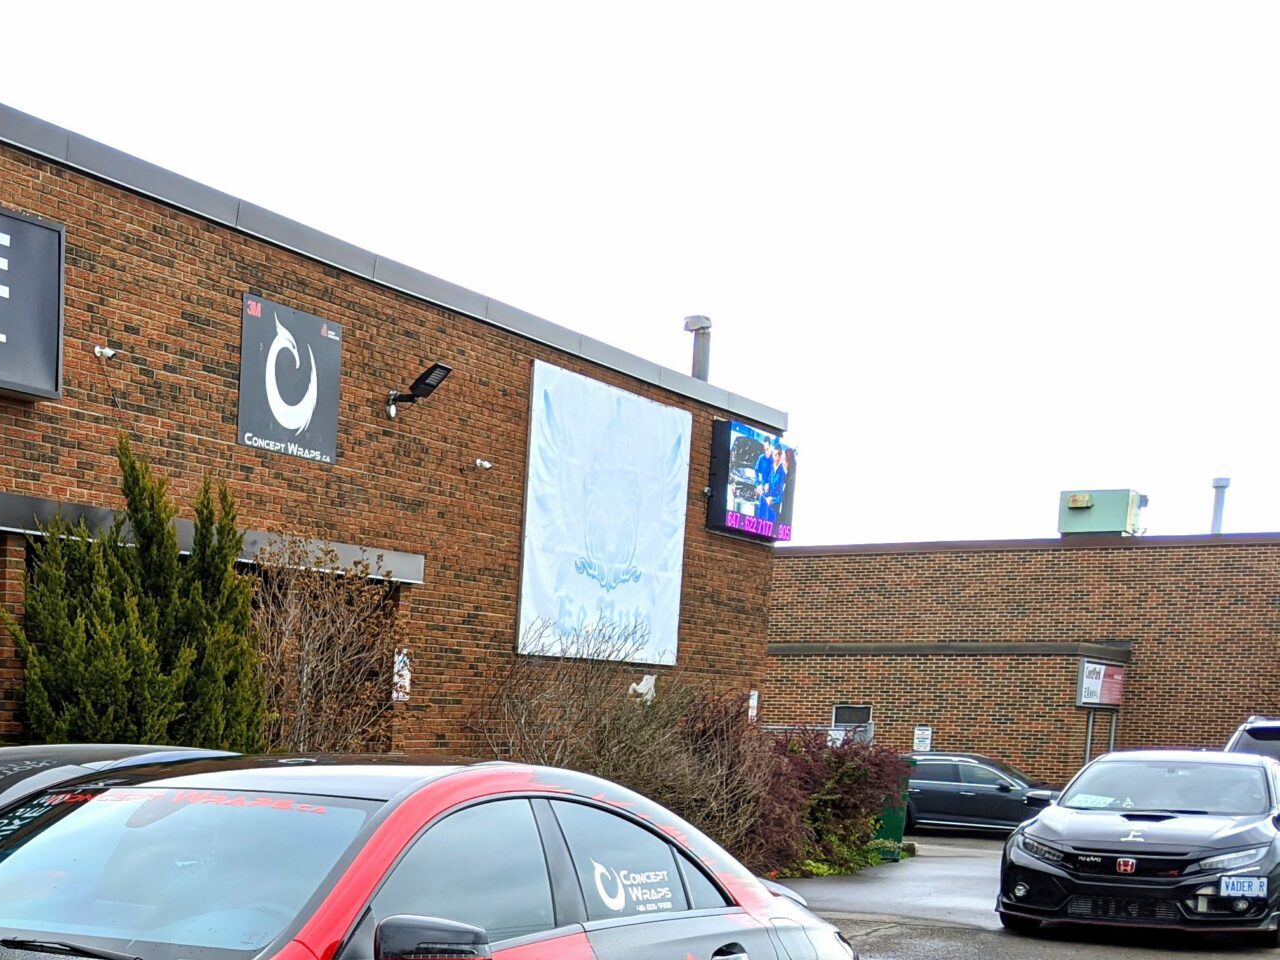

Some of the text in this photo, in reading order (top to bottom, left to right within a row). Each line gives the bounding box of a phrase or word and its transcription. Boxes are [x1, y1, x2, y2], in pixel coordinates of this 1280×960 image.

[247, 300, 262, 318] 3M
[244, 432, 286, 453] CONCEPT
[620, 870, 669, 885] CONCEPT
[628, 886, 672, 901] WRAPS
[1224, 880, 1265, 893] VADER R
